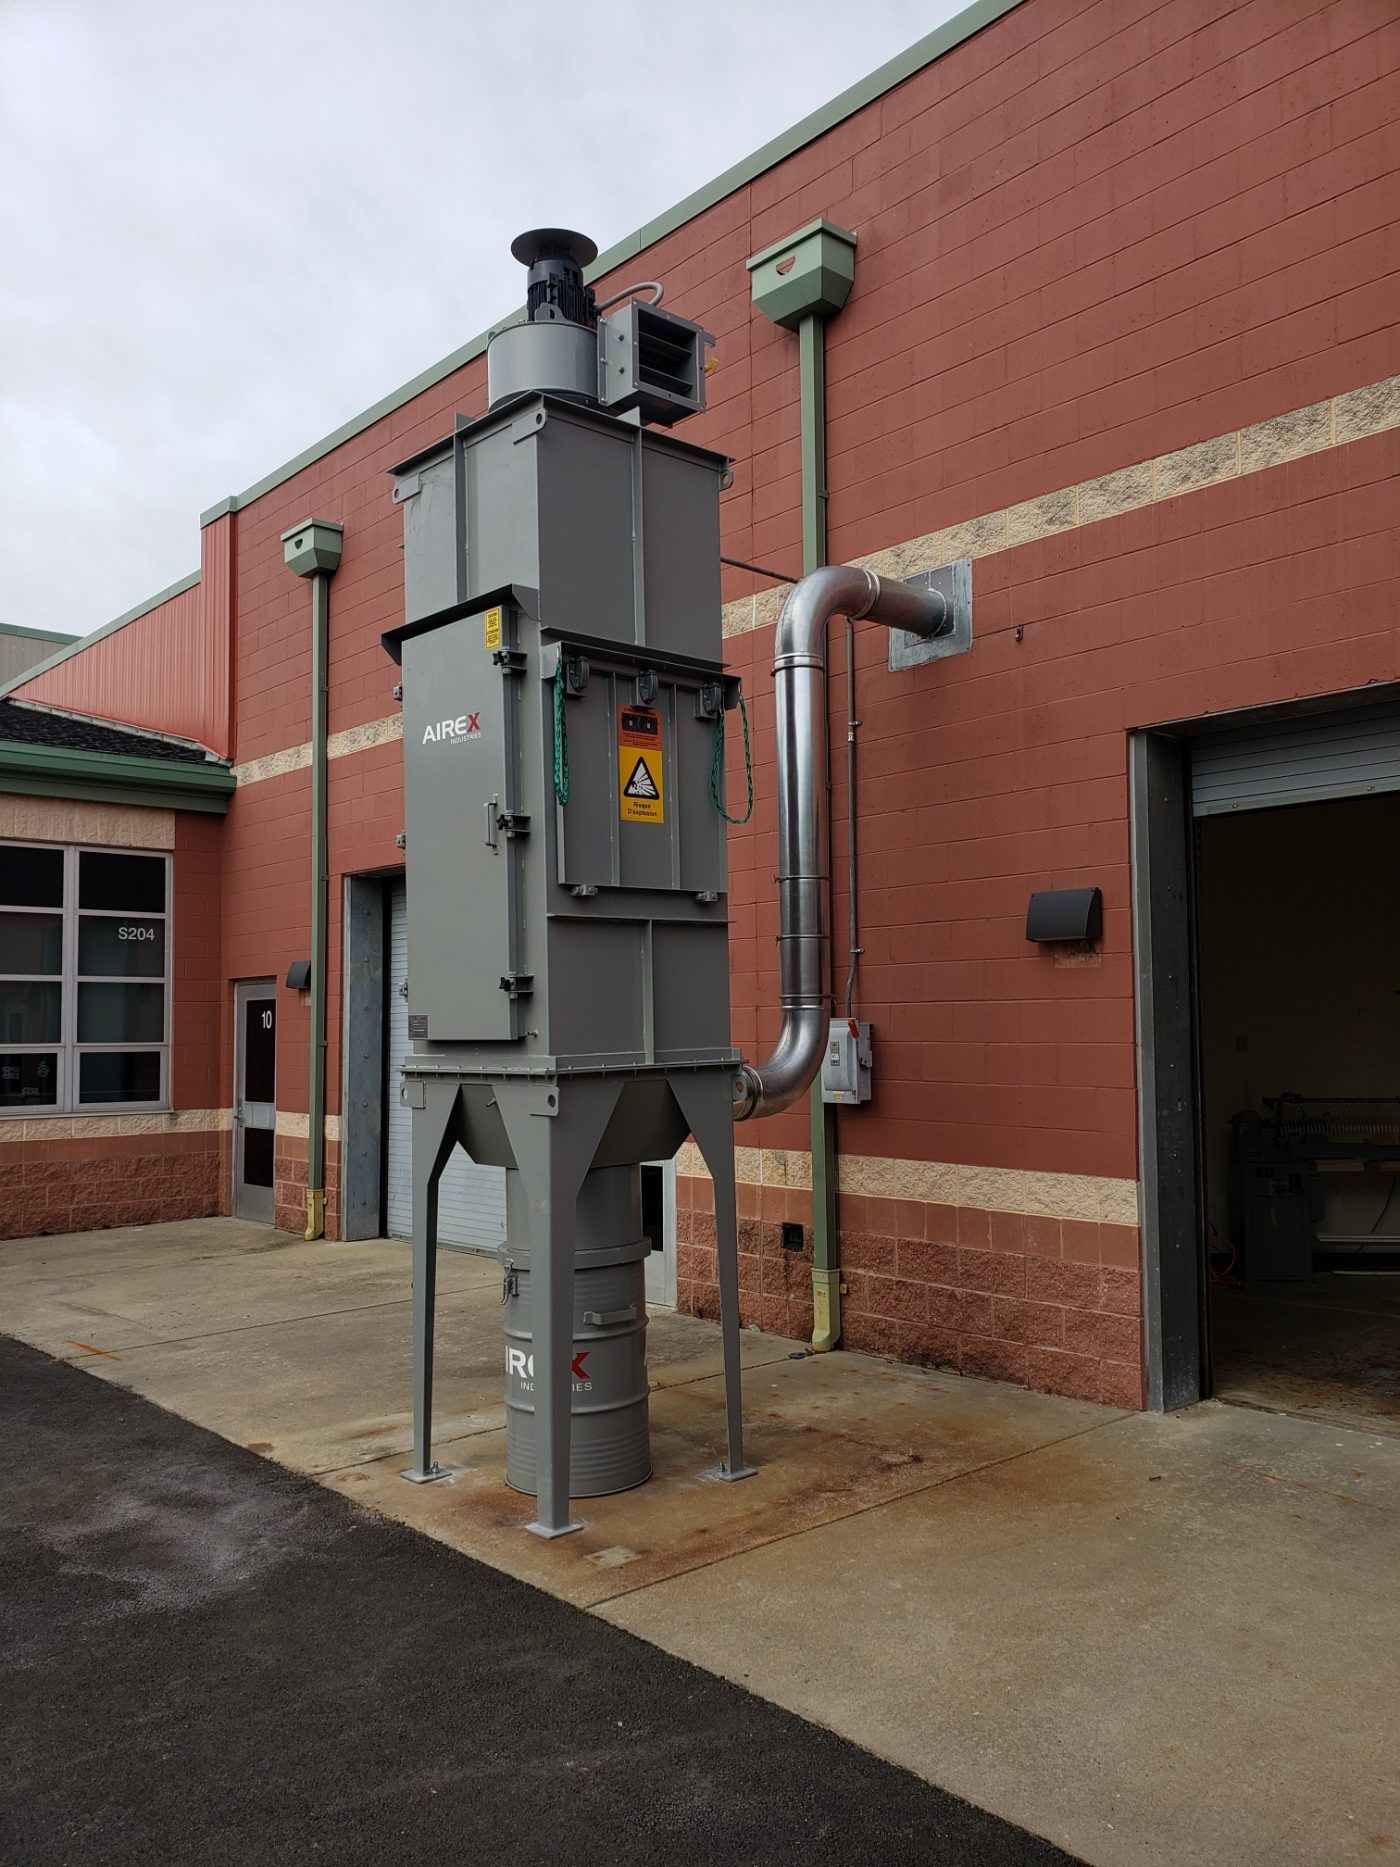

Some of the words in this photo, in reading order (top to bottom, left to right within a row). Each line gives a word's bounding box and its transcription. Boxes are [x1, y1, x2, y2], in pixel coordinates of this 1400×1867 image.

[422, 712, 480, 745] AIREX
[118, 926, 155, 941] S204
[261, 1010, 272, 1029] 10
